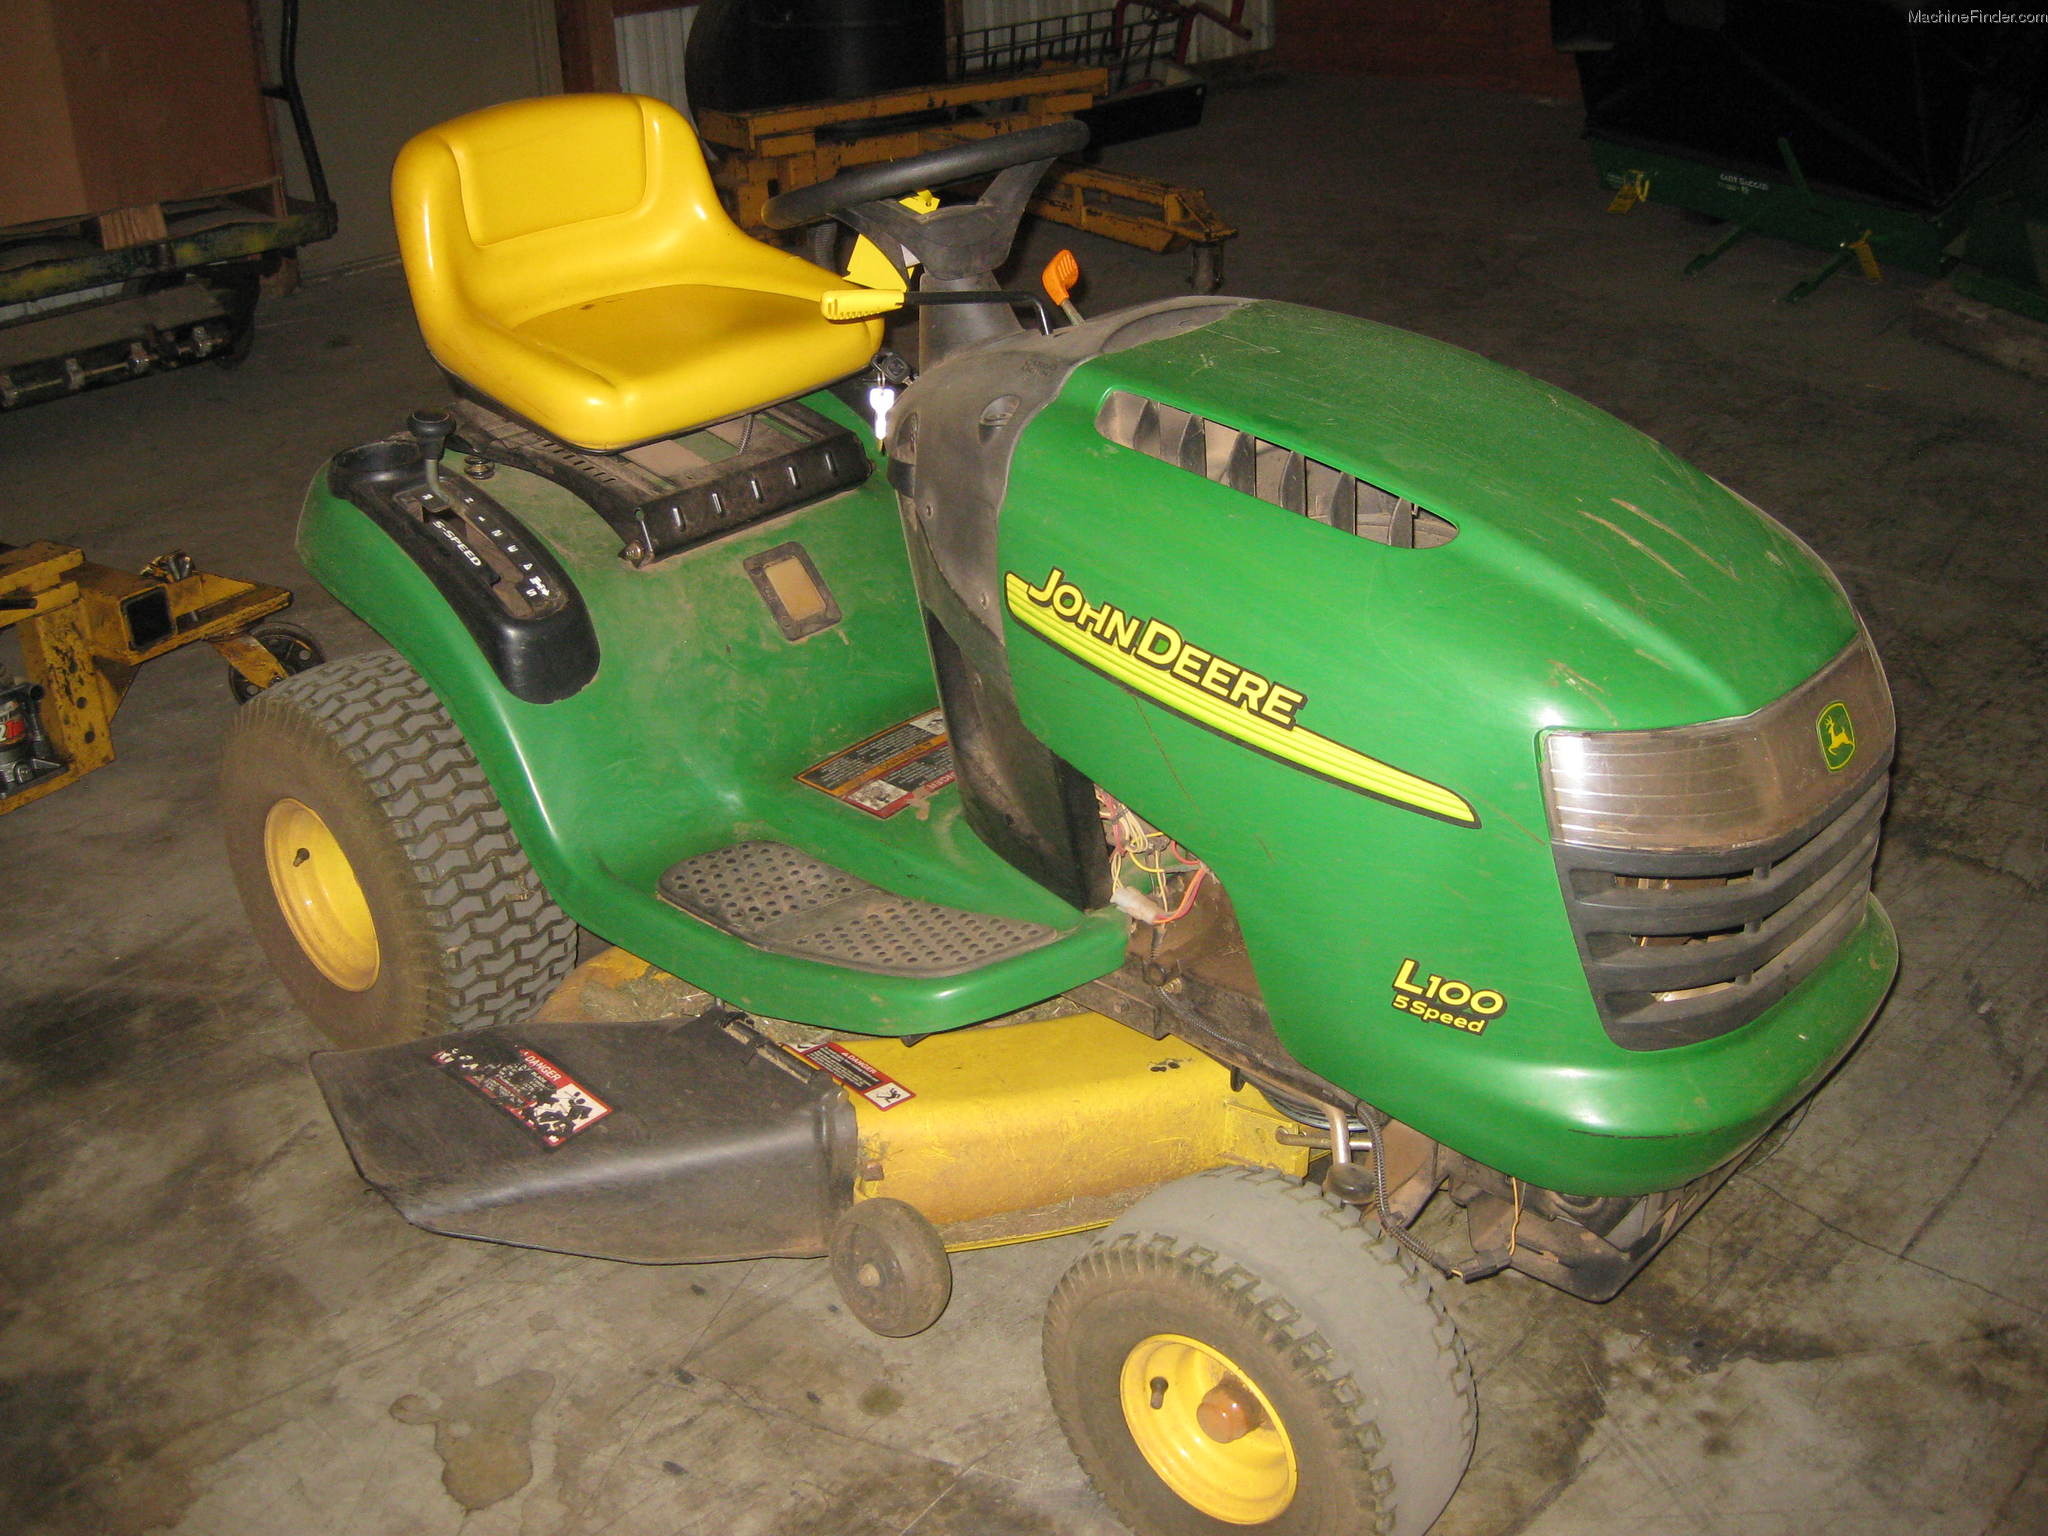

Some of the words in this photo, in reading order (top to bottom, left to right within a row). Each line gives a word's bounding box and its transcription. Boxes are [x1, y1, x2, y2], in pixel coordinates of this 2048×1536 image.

[1027, 567, 1143, 655] JOHN
[1134, 618, 1306, 729] DEERE
[1392, 958, 1506, 1016] L100
[525, 1055, 561, 1081] DANGER
[847, 1054, 878, 1074] DANGER
